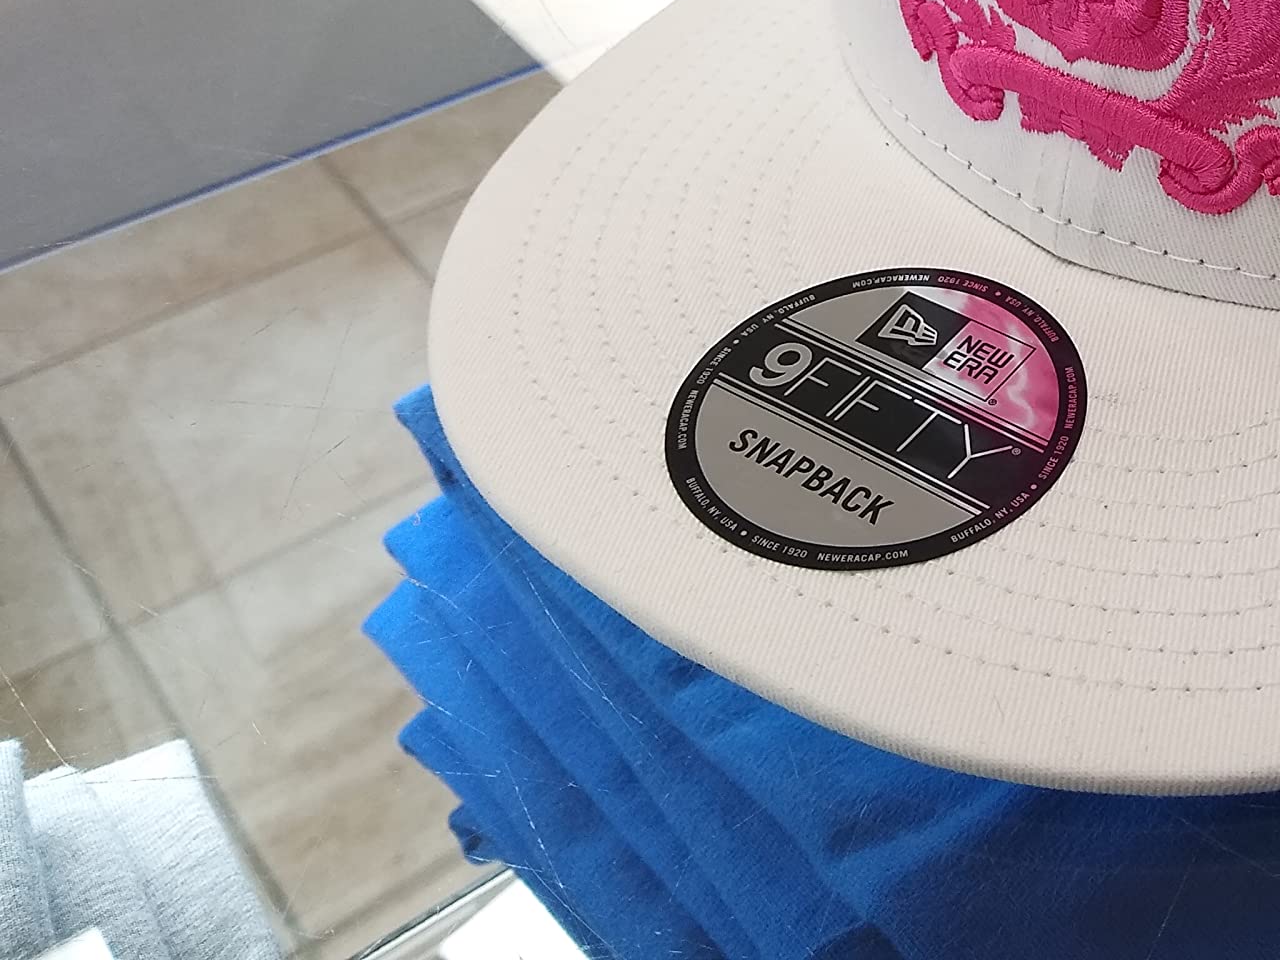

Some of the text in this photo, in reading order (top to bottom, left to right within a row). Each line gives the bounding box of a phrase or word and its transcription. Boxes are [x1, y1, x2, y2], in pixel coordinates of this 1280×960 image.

[943, 350, 999, 385] ERA
[956, 335, 1015, 369] NEW
[1064, 366, 1078, 429] NEWERACAP.COM
[1038, 435, 1069, 480] SINCE 1920
[729, 429, 894, 526] SNAPBACK
[1010, 492, 1030, 507] USA
[719, 516, 738, 532] USA
[751, 535, 808, 558] SINCE 1920
[817, 549, 909, 563] NEWERACAP.COM
